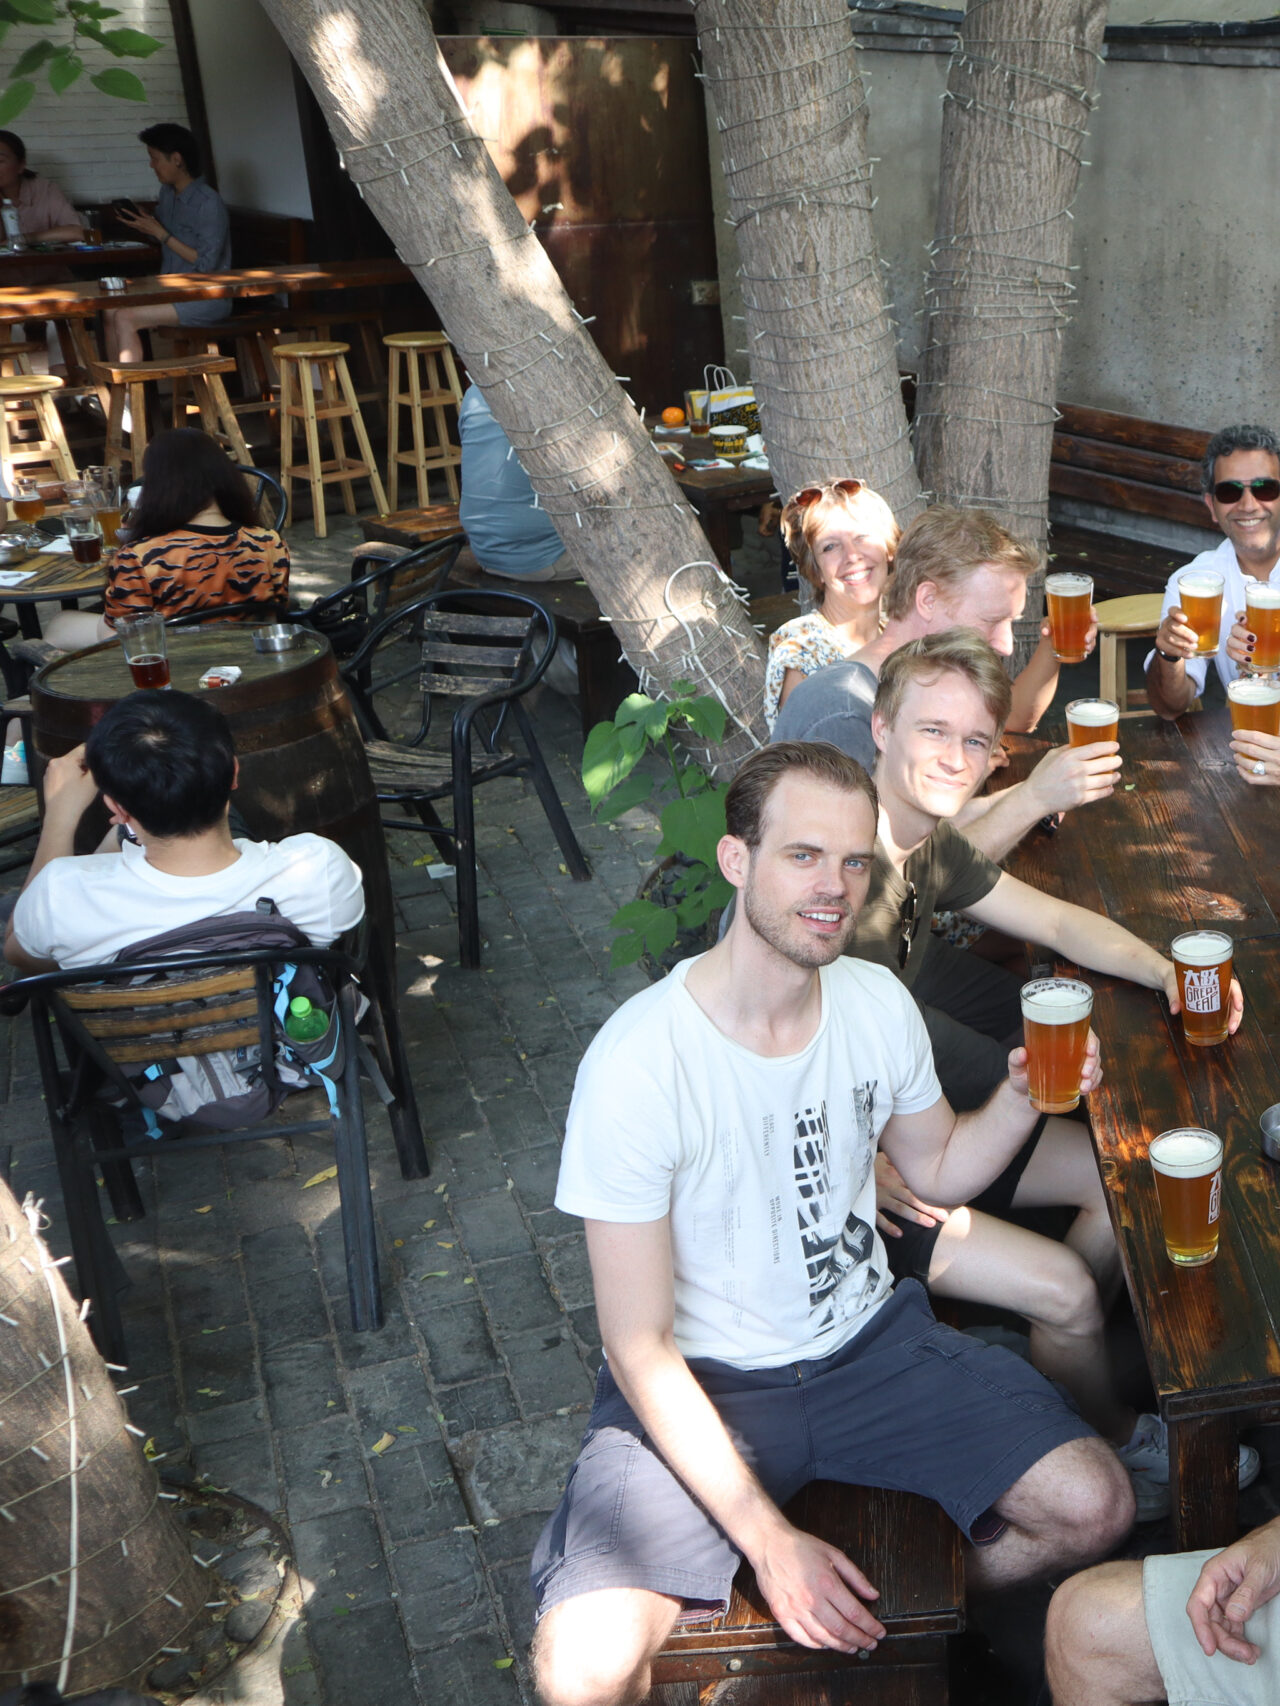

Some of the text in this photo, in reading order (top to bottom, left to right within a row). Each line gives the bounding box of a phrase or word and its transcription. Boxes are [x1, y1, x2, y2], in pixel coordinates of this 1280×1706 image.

[1186, 985, 1218, 1002] GREAT
[1187, 991, 1219, 1011] LEAP
[772, 1229, 781, 1265] DIRECTIONS
